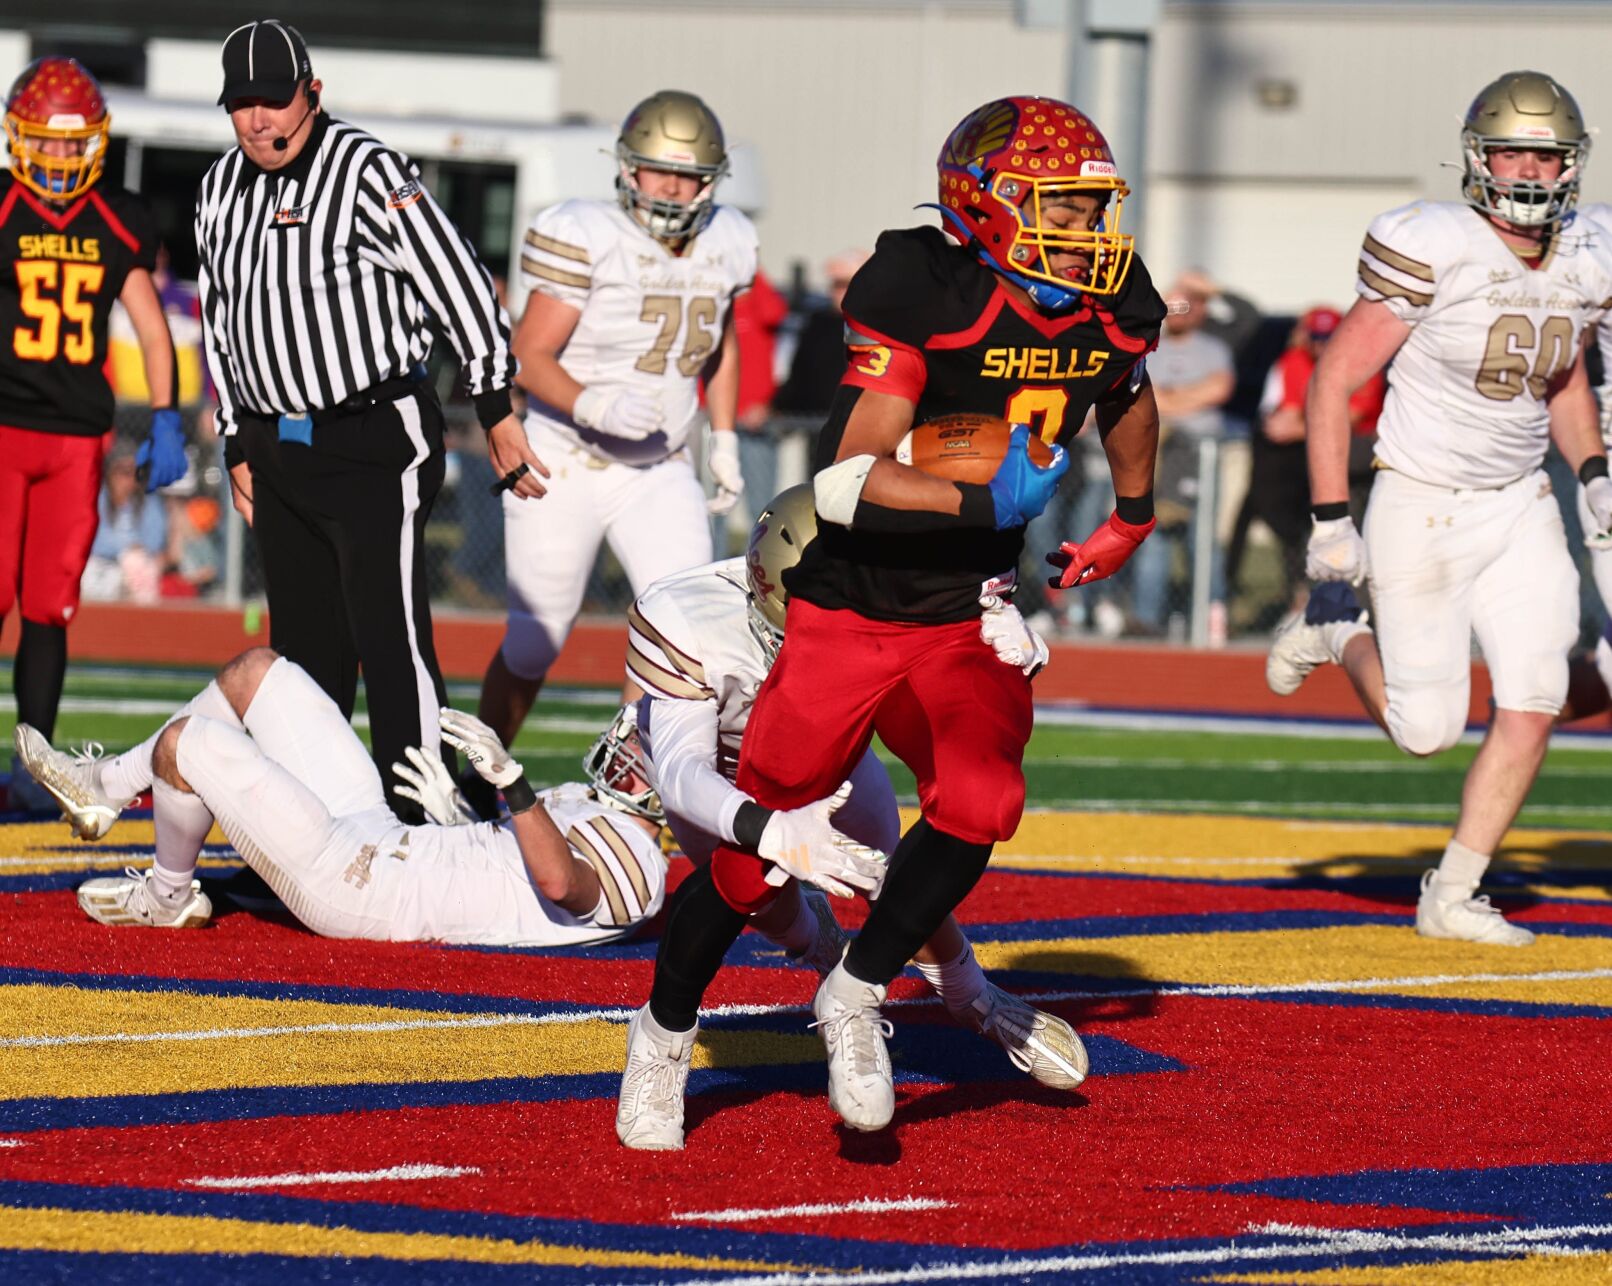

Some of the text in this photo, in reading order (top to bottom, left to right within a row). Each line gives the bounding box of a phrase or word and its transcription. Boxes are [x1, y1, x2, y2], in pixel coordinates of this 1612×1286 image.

[18, 233, 101, 262] SHELLS
[13, 258, 105, 365] 55
[633, 294, 719, 378] 76
[855, 346, 894, 379] 3
[980, 346, 1111, 380] SHELLS
[1474, 313, 1575, 402] 60
